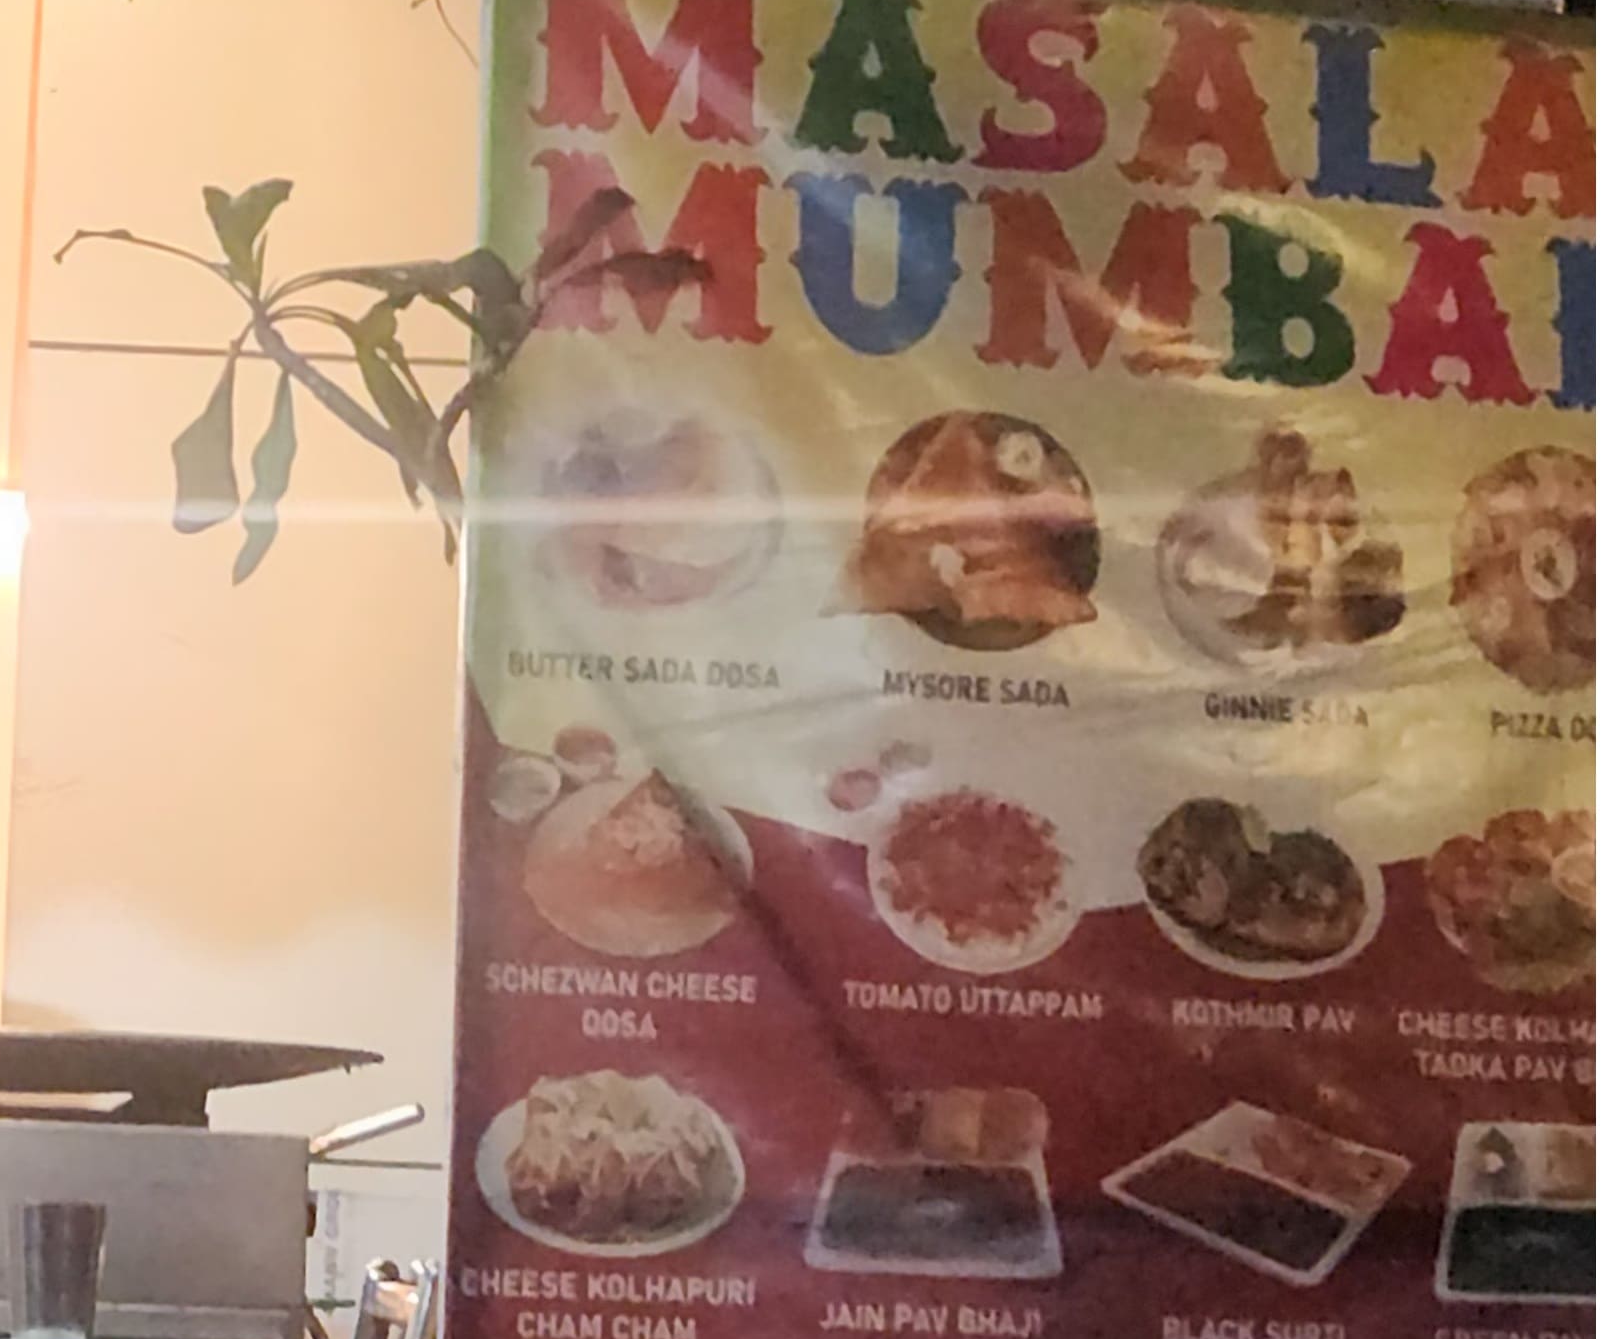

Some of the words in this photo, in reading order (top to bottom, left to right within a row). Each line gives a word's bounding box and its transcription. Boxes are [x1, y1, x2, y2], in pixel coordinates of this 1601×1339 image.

[529, 149, 1596, 412] MUMBAI
[507, 651, 614, 681] BUTTER
[624, 656, 697, 684] SADA
[706, 660, 780, 689] DOSA
[883, 669, 990, 703] MYSORE
[1000, 678, 1070, 707] SADA
[1204, 692, 1293, 723] GINNIE
[1491, 710, 1563, 739] PIZZA
[484, 962, 639, 997] SCHEZWAN
[646, 970, 757, 1003] CHEESE
[843, 979, 952, 1014] TOMATO
[959, 986, 1103, 1020] UTTAPPAM
[581, 1008, 657, 1039] DOSA
[1302, 1003, 1355, 1033] PAV
[1398, 1009, 1505, 1040] CHEESE
[1514, 1053, 1566, 1082] PAV
[460, 1267, 578, 1299] CHEESE
[587, 1272, 756, 1306] KOLHAPURI
[819, 1302, 885, 1332] JAIN
[894, 1302, 948, 1335] PAV
[958, 1305, 1042, 1338] BHAJI
